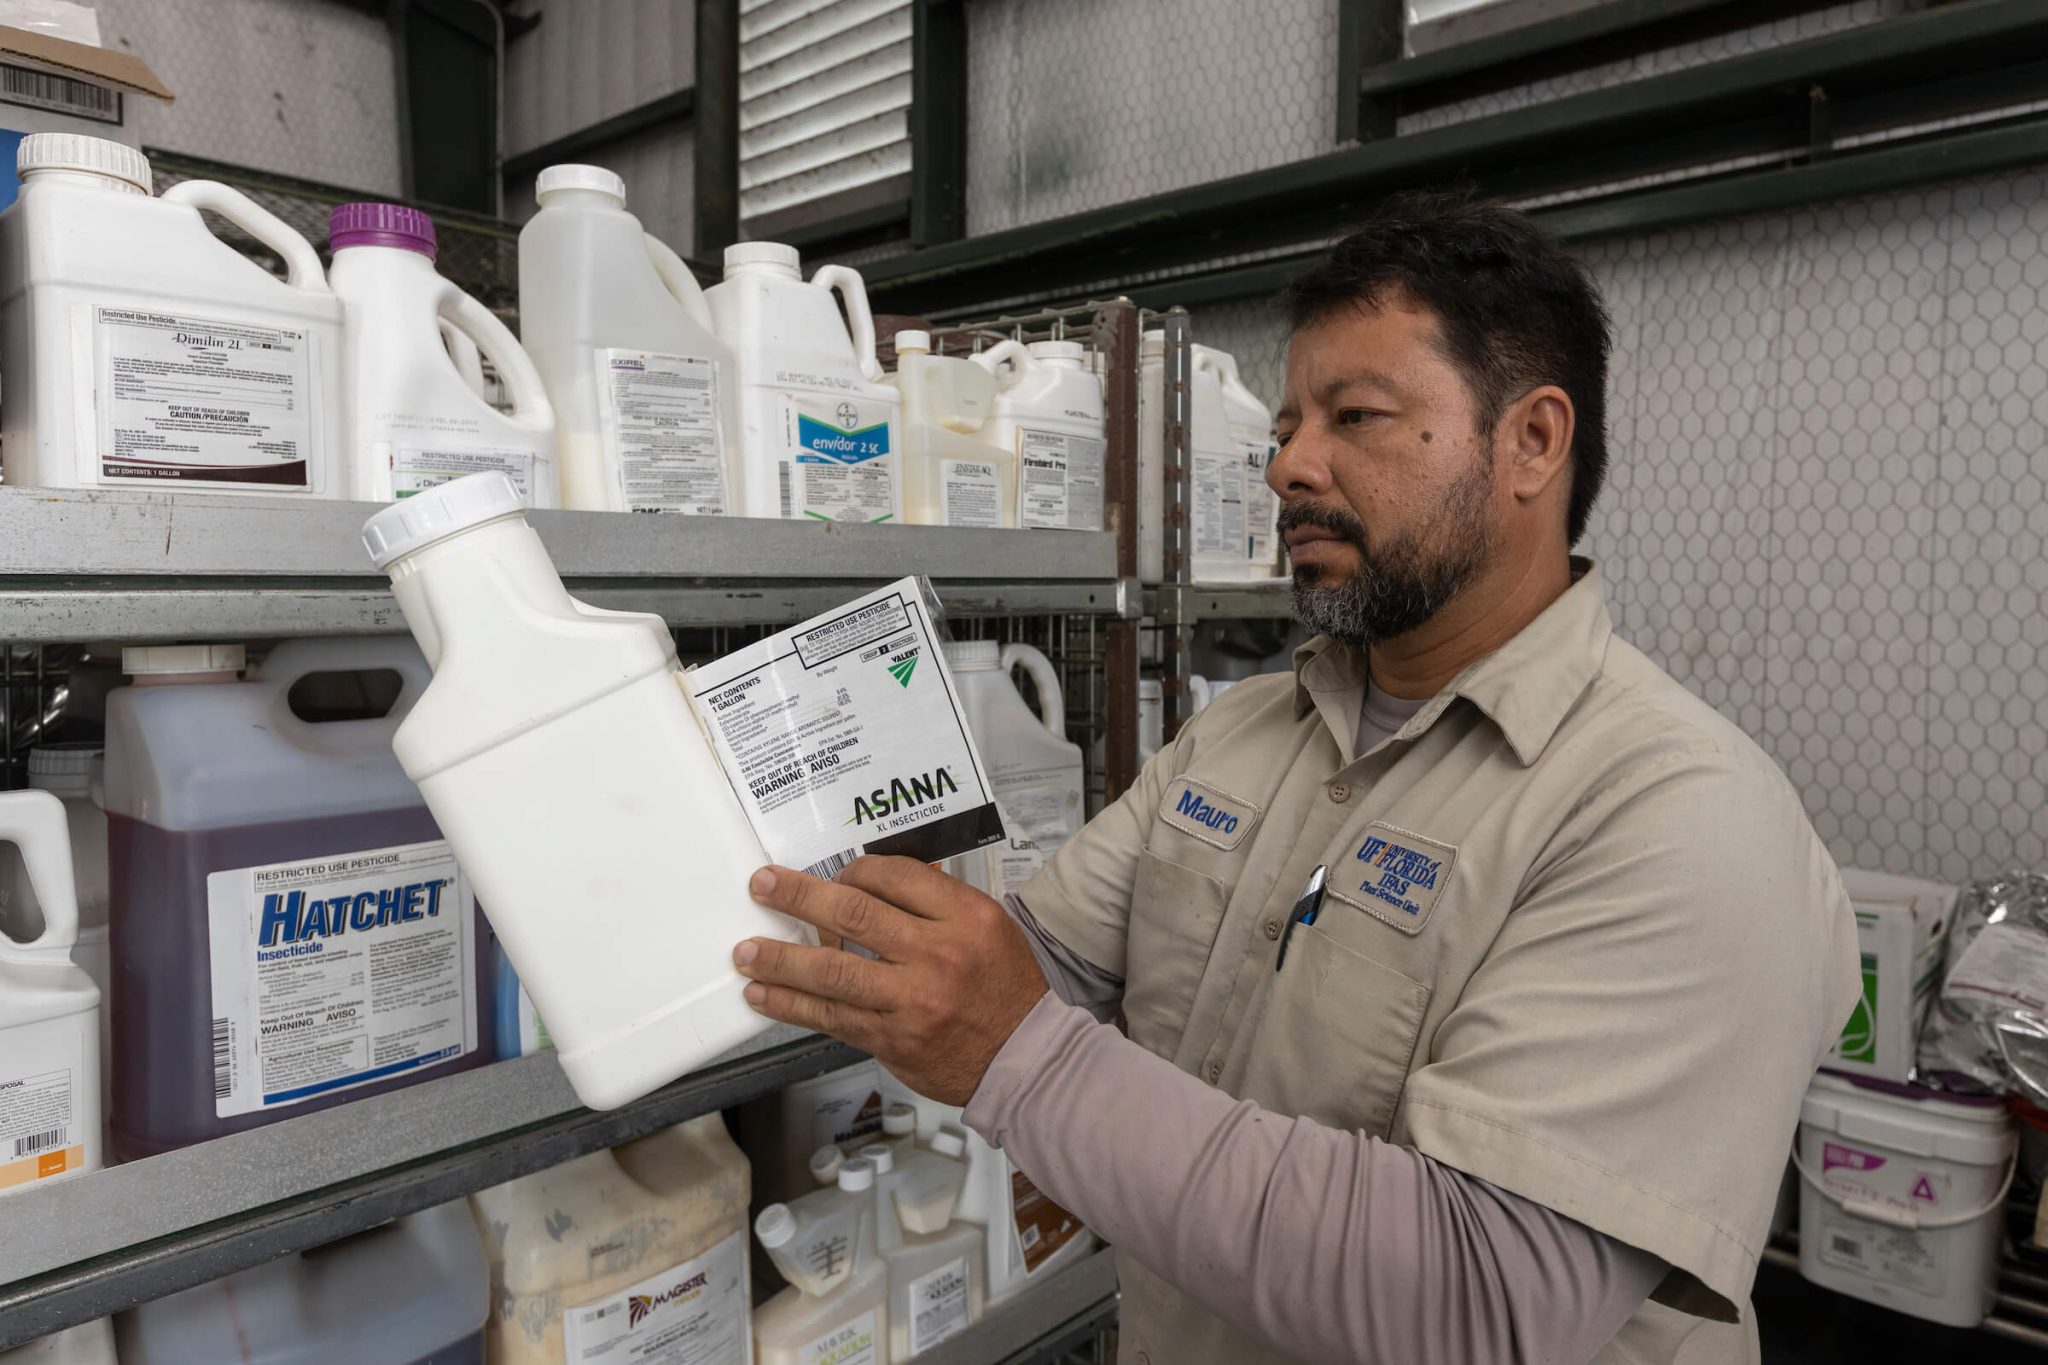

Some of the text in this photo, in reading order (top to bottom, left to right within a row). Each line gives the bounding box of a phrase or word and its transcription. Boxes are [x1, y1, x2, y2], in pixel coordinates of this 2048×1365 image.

[136, 313, 147, 321] Use
[172, 332, 224, 348] Dimilin
[422, 452, 460, 461] RESTRICTED
[475, 455, 505, 464] PESTICIDE
[860, 442, 866, 453] 2
[868, 443, 879, 454] SC
[1024, 458, 1066, 470] Firebird Pro
[805, 601, 891, 642] RESTRICTED USE PESTICIDE
[891, 650, 918, 663] VALENT
[707, 676, 761, 705] NET CONTENTS
[716, 692, 746, 710] GALLON
[748, 776, 767, 789] KEEP
[767, 767, 783, 780] OUT
[782, 763, 793, 772] OF
[817, 748, 827, 758] OF
[826, 736, 858, 754] CHILDREN
[751, 767, 806, 799] WARNING
[808, 752, 840, 773] AVISO
[854, 767, 958, 824] ASANA
[876, 803, 945, 833] XL INSECTICIDE
[1176, 790, 1238, 834] Mauro
[1010, 838, 1039, 850] Lan
[1357, 835, 1387, 863] UF
[257, 854, 400, 881] RESTRICTED USE PESTICIDE
[1376, 852, 1438, 890] FLORIDA
[1388, 844, 1442, 873] UNIVERSITY of
[1360, 881, 1378, 895] Plant
[1376, 888, 1403, 907] Science
[1378, 872, 1410, 896] IFAS
[258, 877, 447, 947] HATCHET
[257, 942, 323, 962] Insecticide
[261, 1016, 279, 1025] Keep
[305, 1007, 326, 1017] Reach
[337, 999, 364, 1009] Children
[261, 1008, 356, 1034] WARNING AVISO
[652, 1272, 708, 1310] MAGISTER
